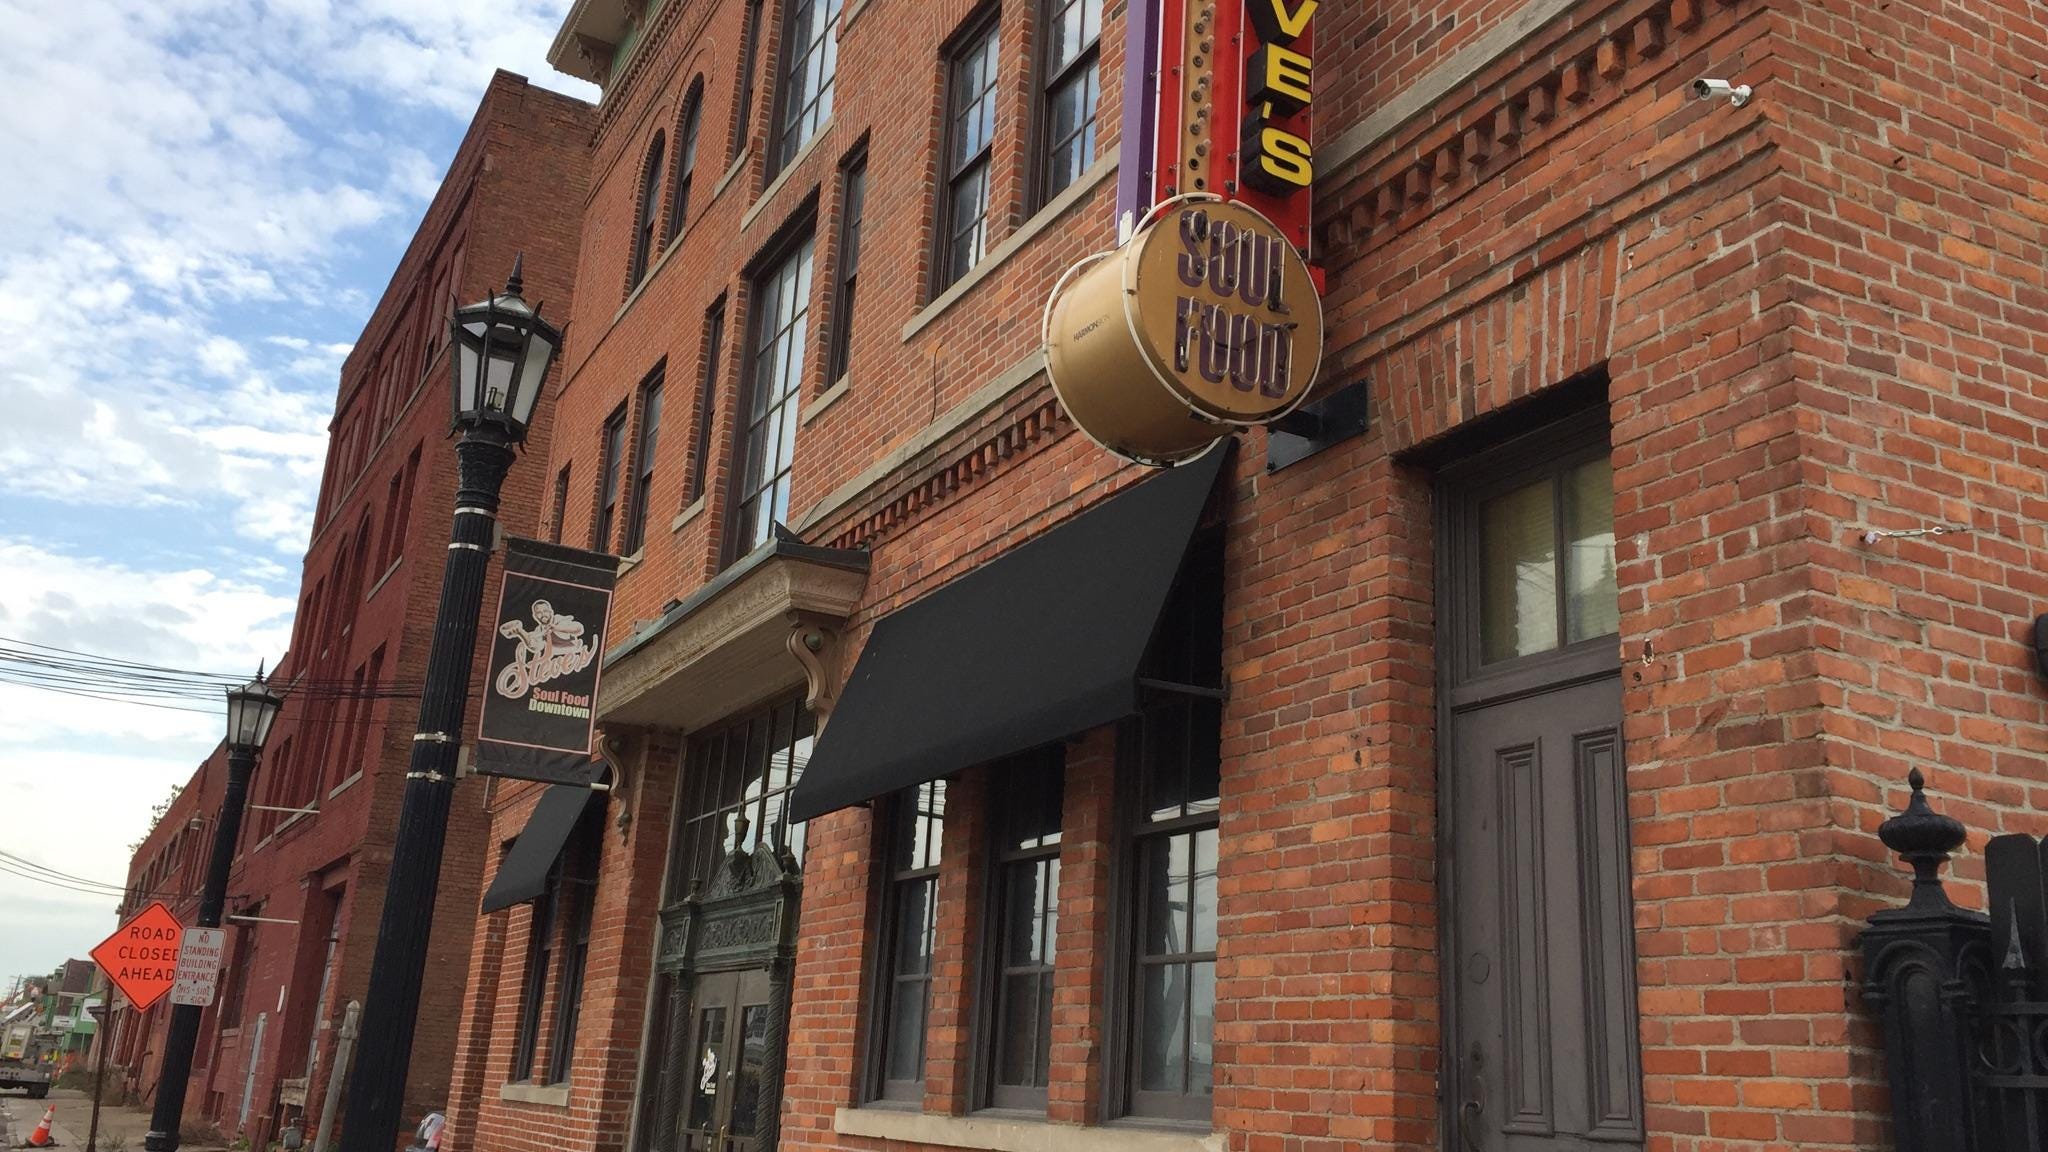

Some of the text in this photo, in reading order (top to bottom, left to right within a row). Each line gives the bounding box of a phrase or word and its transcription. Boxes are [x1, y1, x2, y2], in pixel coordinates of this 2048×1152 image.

[1261, 0, 1319, 188] VE'S
[1177, 209, 1290, 315] SOUL
[1175, 296, 1298, 399] FOOD
[533, 686, 589, 707] Soul Food
[528, 698, 590, 719] Downtown
[130, 926, 176, 941] ROAD
[198, 934, 210, 944] NO
[183, 945, 220, 958] STANDING
[180, 958, 217, 970] BUILDING
[118, 966, 175, 982] AHEAD
[177, 970, 216, 983] ENTRANCE
